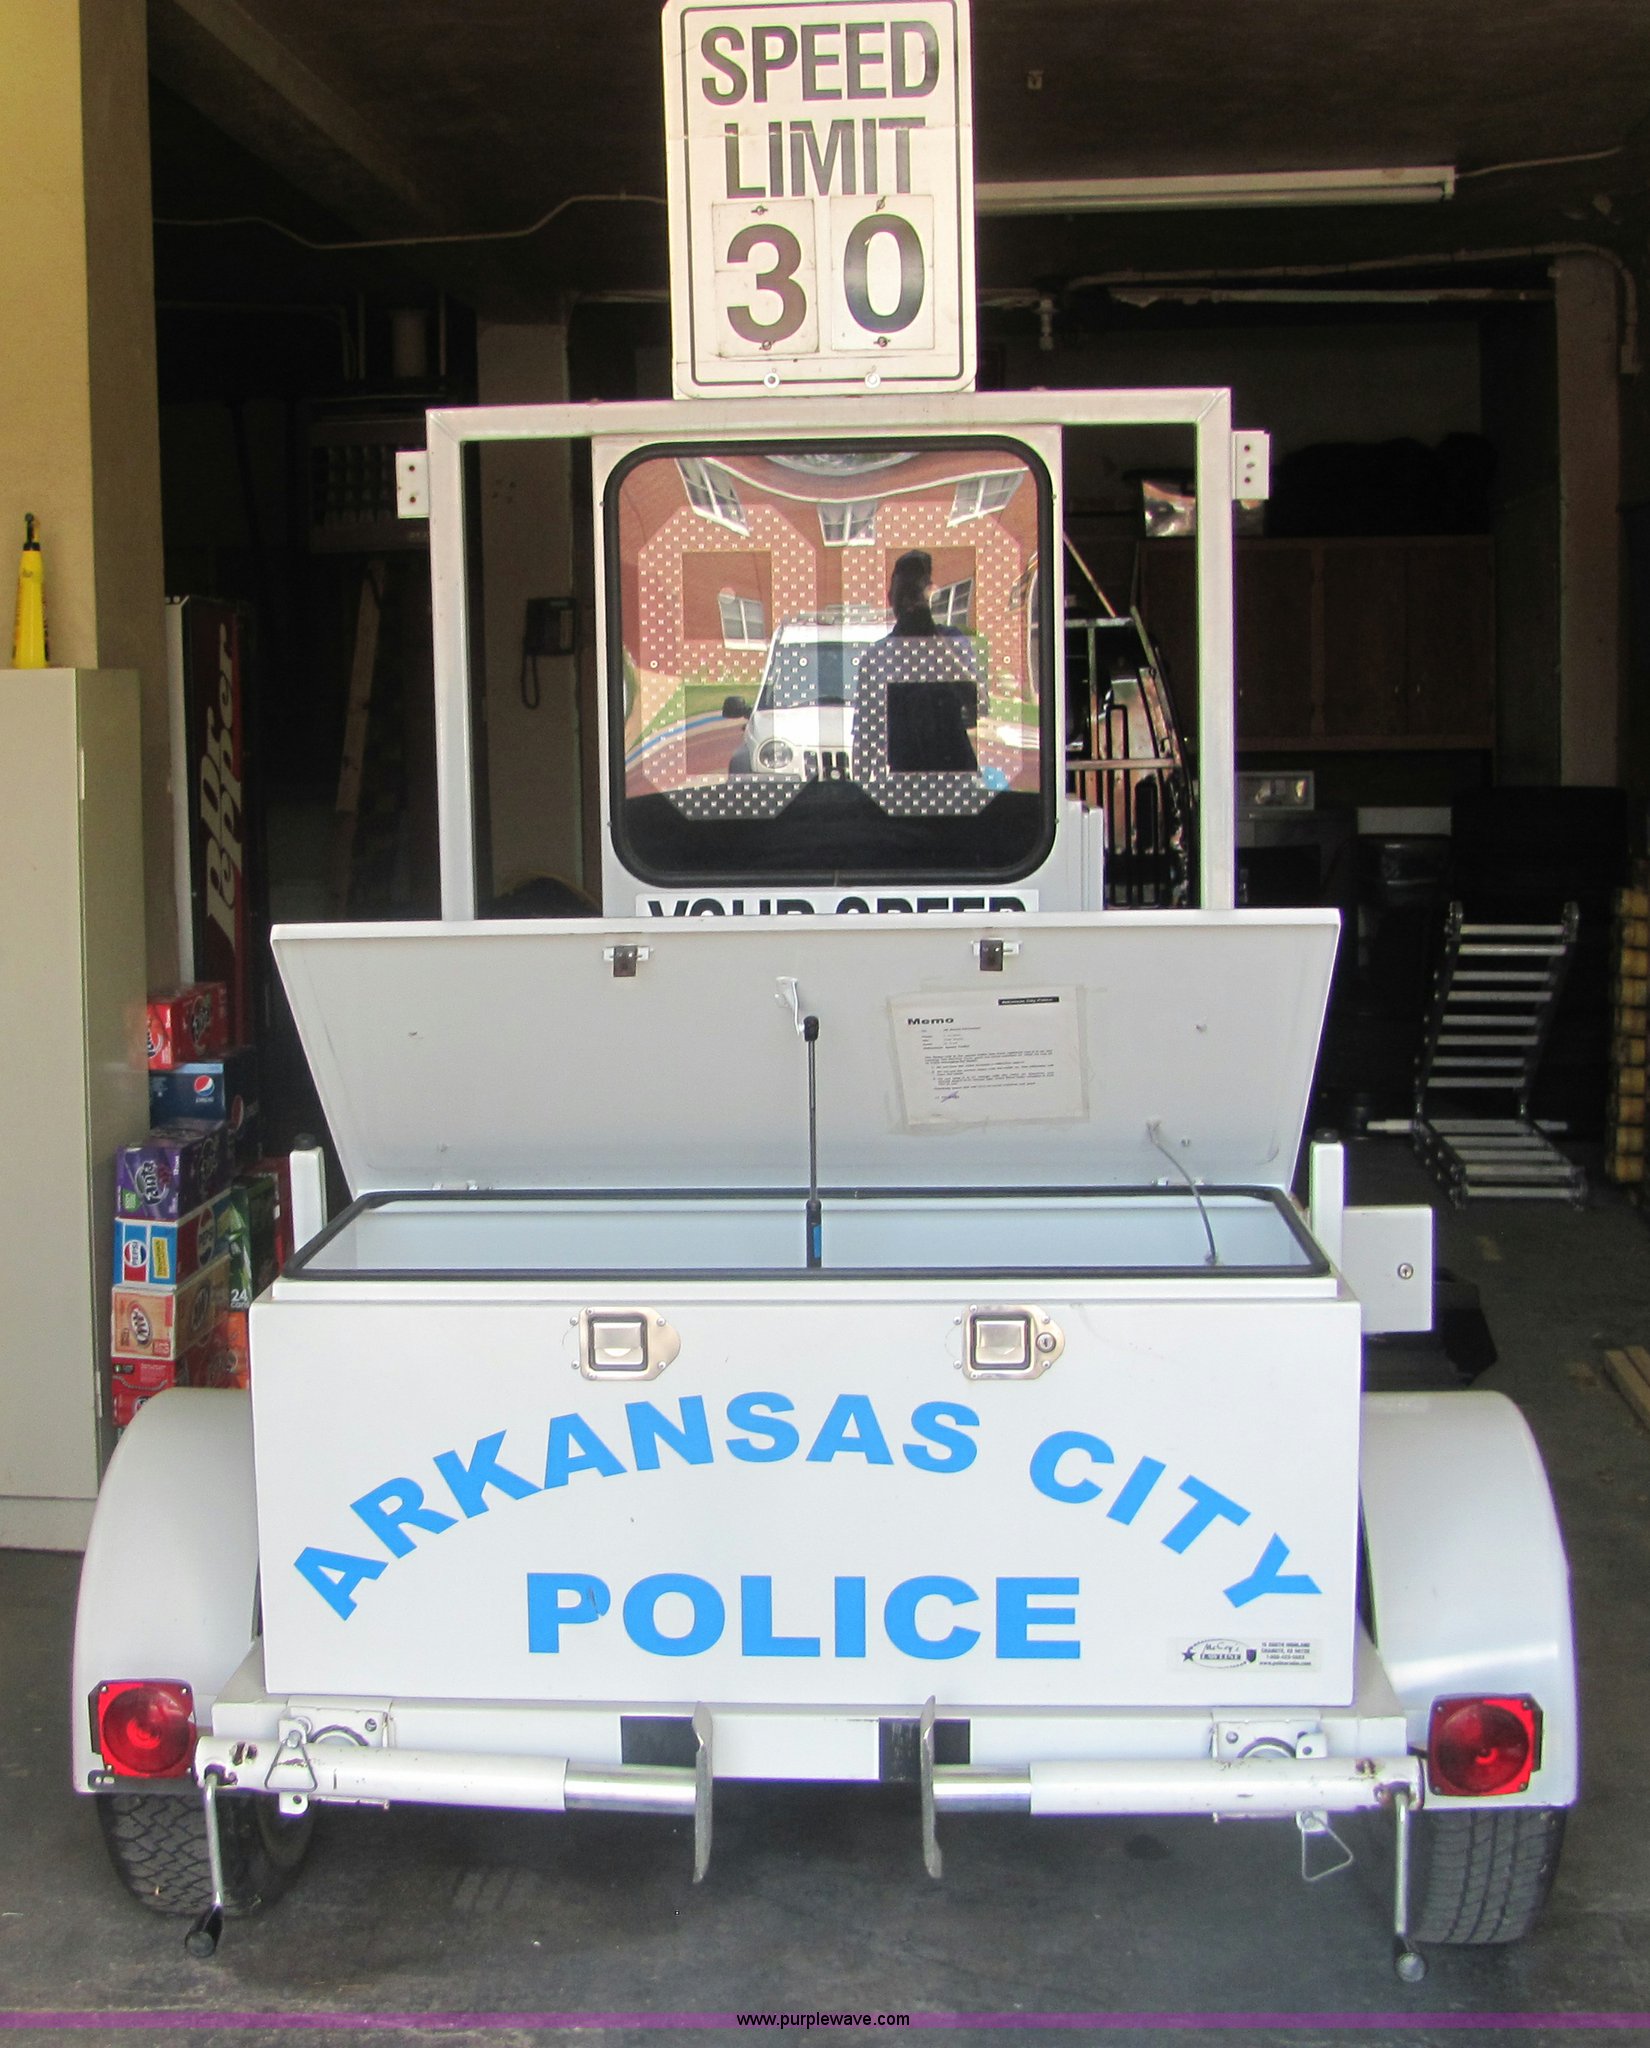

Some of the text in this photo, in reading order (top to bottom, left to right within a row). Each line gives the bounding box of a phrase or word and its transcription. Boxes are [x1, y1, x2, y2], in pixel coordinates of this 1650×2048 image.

[701, 21, 940, 105] SPEED
[724, 117, 926, 199] LIMIT
[726, 213, 925, 344] 30
[200, 705, 221, 840] Dr
[207, 622, 242, 950] Pepper
[907, 1017, 954, 1025] Memo
[141, 1160, 160, 1205] Fanta
[131, 1241, 139, 1266] PEPSI
[231, 1288, 248, 1302] 24
[293, 1391, 1322, 1621] ARKANSAS CITY
[527, 1573, 1081, 1659] POLICE
